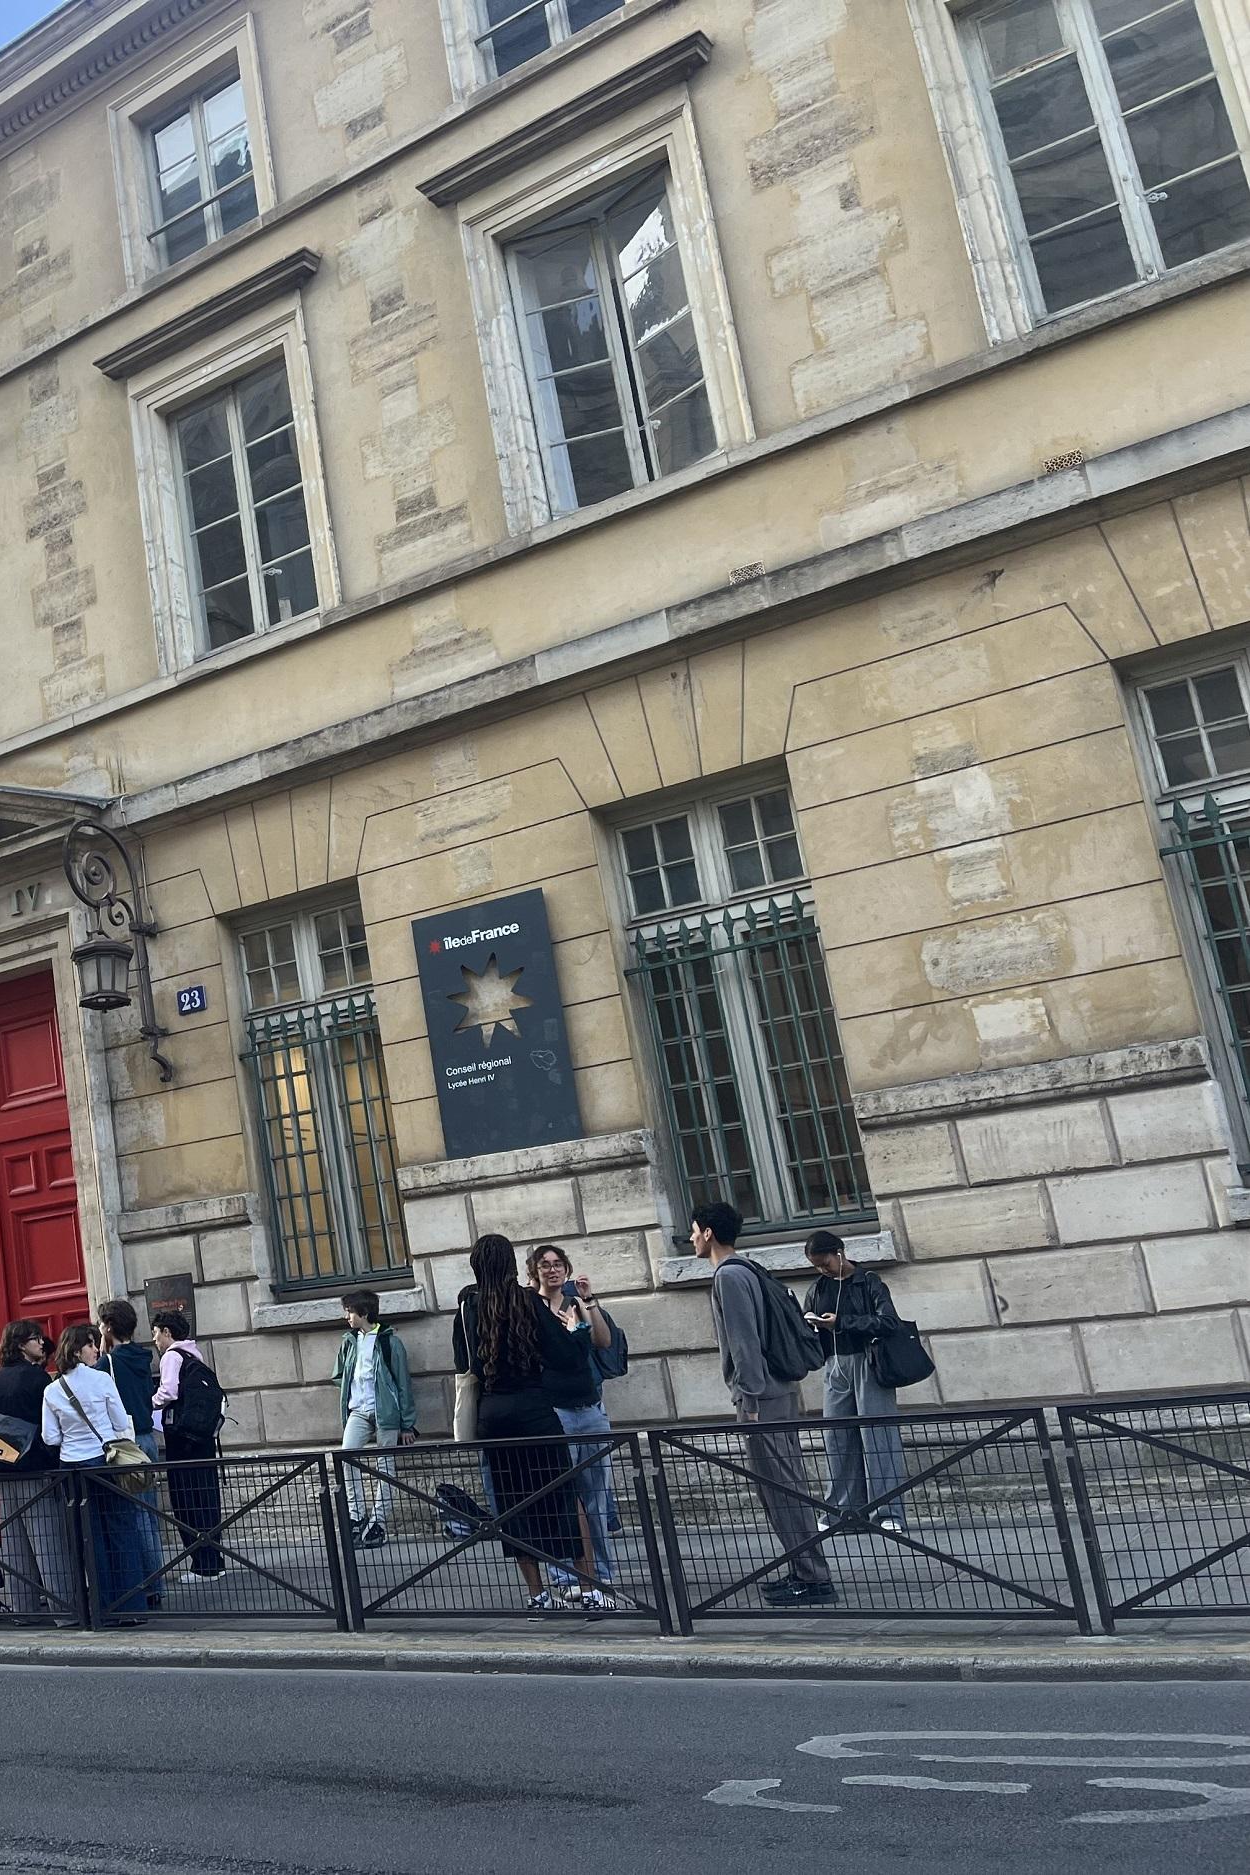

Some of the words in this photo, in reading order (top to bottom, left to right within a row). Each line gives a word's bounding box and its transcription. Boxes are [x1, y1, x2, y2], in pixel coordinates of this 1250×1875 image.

[10, 884, 41, 916] IV
[180, 990, 201, 1011] 23
[446, 1062, 477, 1076] Conseil
[478, 1055, 512, 1071] régional
[447, 1079, 468, 1090] Lycée
[468, 1076, 486, 1085] Henri
[487, 1073, 495, 1081] IV
